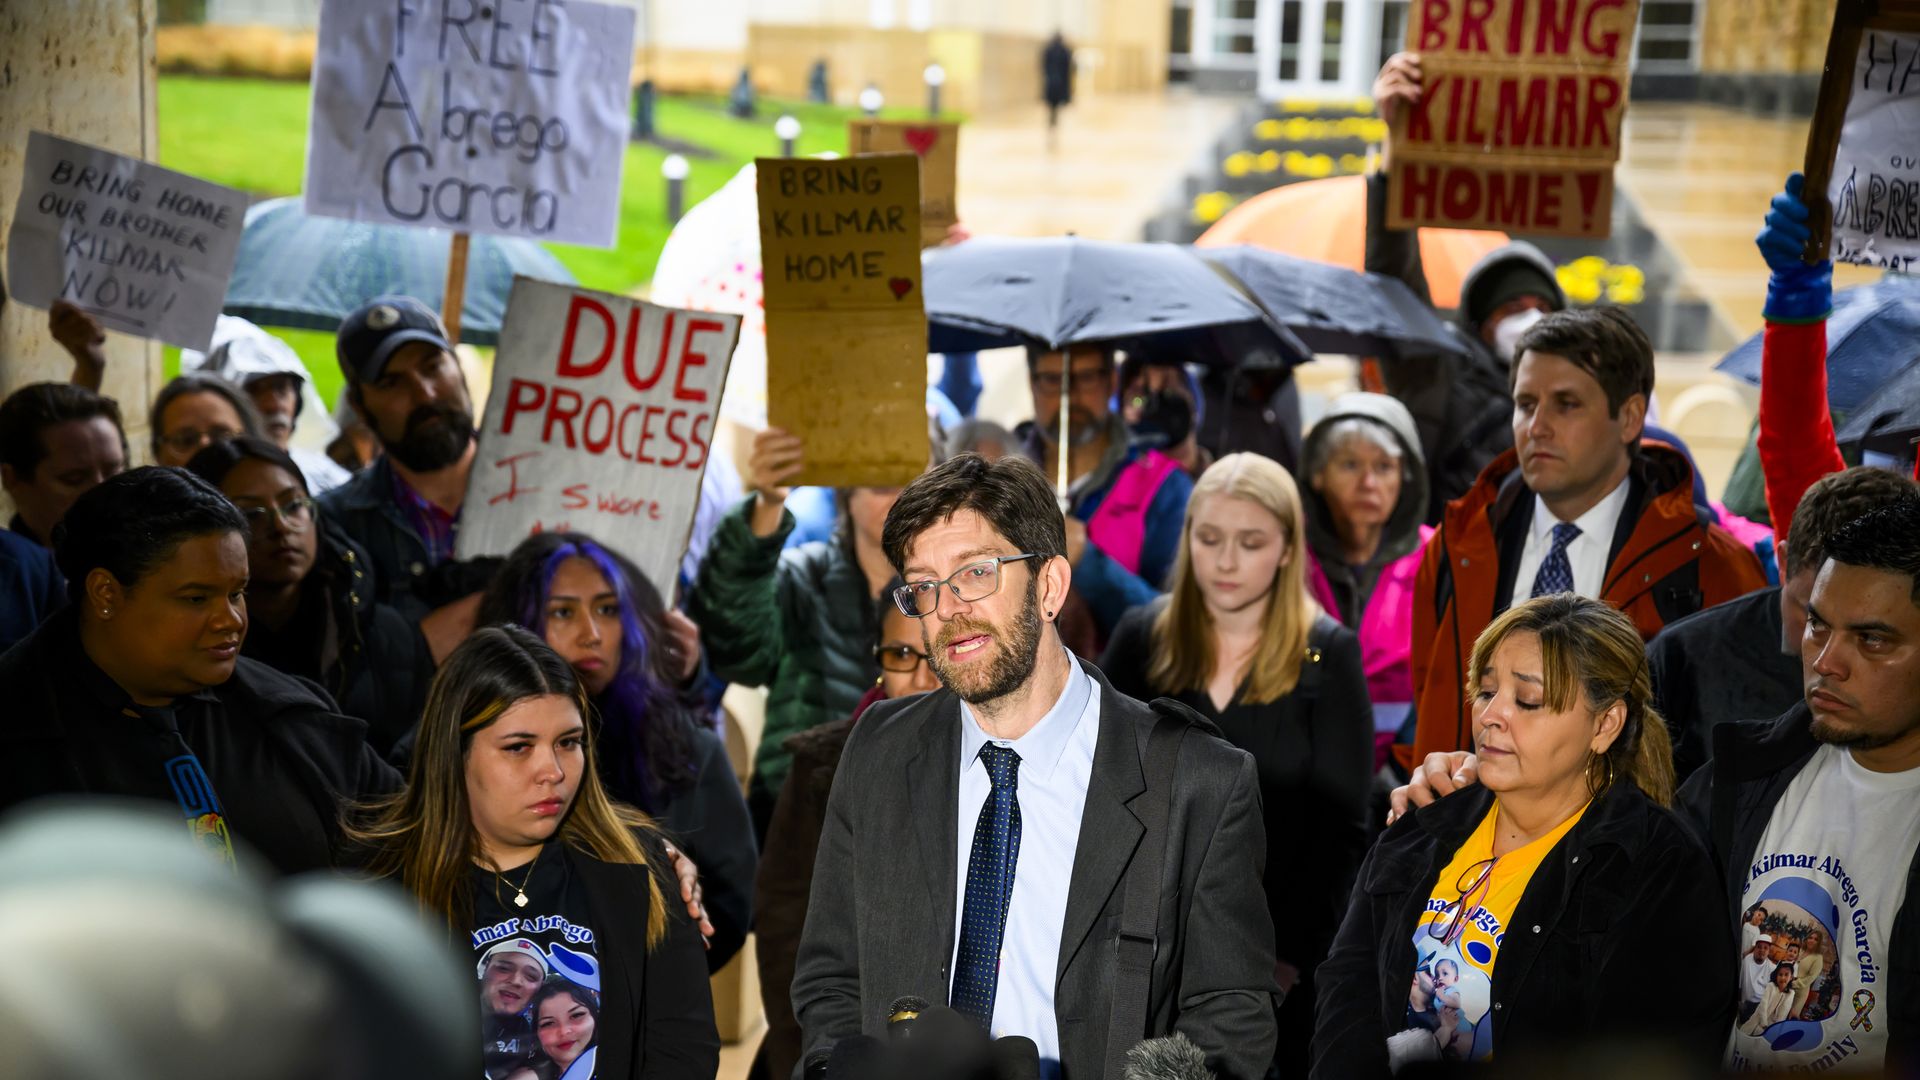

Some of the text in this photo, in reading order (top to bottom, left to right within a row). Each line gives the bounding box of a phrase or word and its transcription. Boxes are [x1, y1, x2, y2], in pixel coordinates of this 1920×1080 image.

[1418, 0, 1624, 59] BRING
[1406, 74, 1622, 149] KILMAR
[381, 143, 558, 234] Garcia
[779, 165, 882, 198] BRING
[1890, 155, 1920, 170] OU
[38, 191, 208, 253] OUR BROTHER
[50, 159, 231, 229] BRING HOME
[773, 204, 907, 239] KILMAR
[1833, 165, 1920, 241] ABRE
[65, 227, 186, 283] KILMAR
[785, 250, 885, 282] HOME
[556, 293, 725, 403] DUE
[501, 377, 710, 470] PROCESS
[489, 450, 543, 507] I
[521, 915, 594, 944] Abrego
[1751, 853, 1880, 984] Kilmar Abrego Garcia
